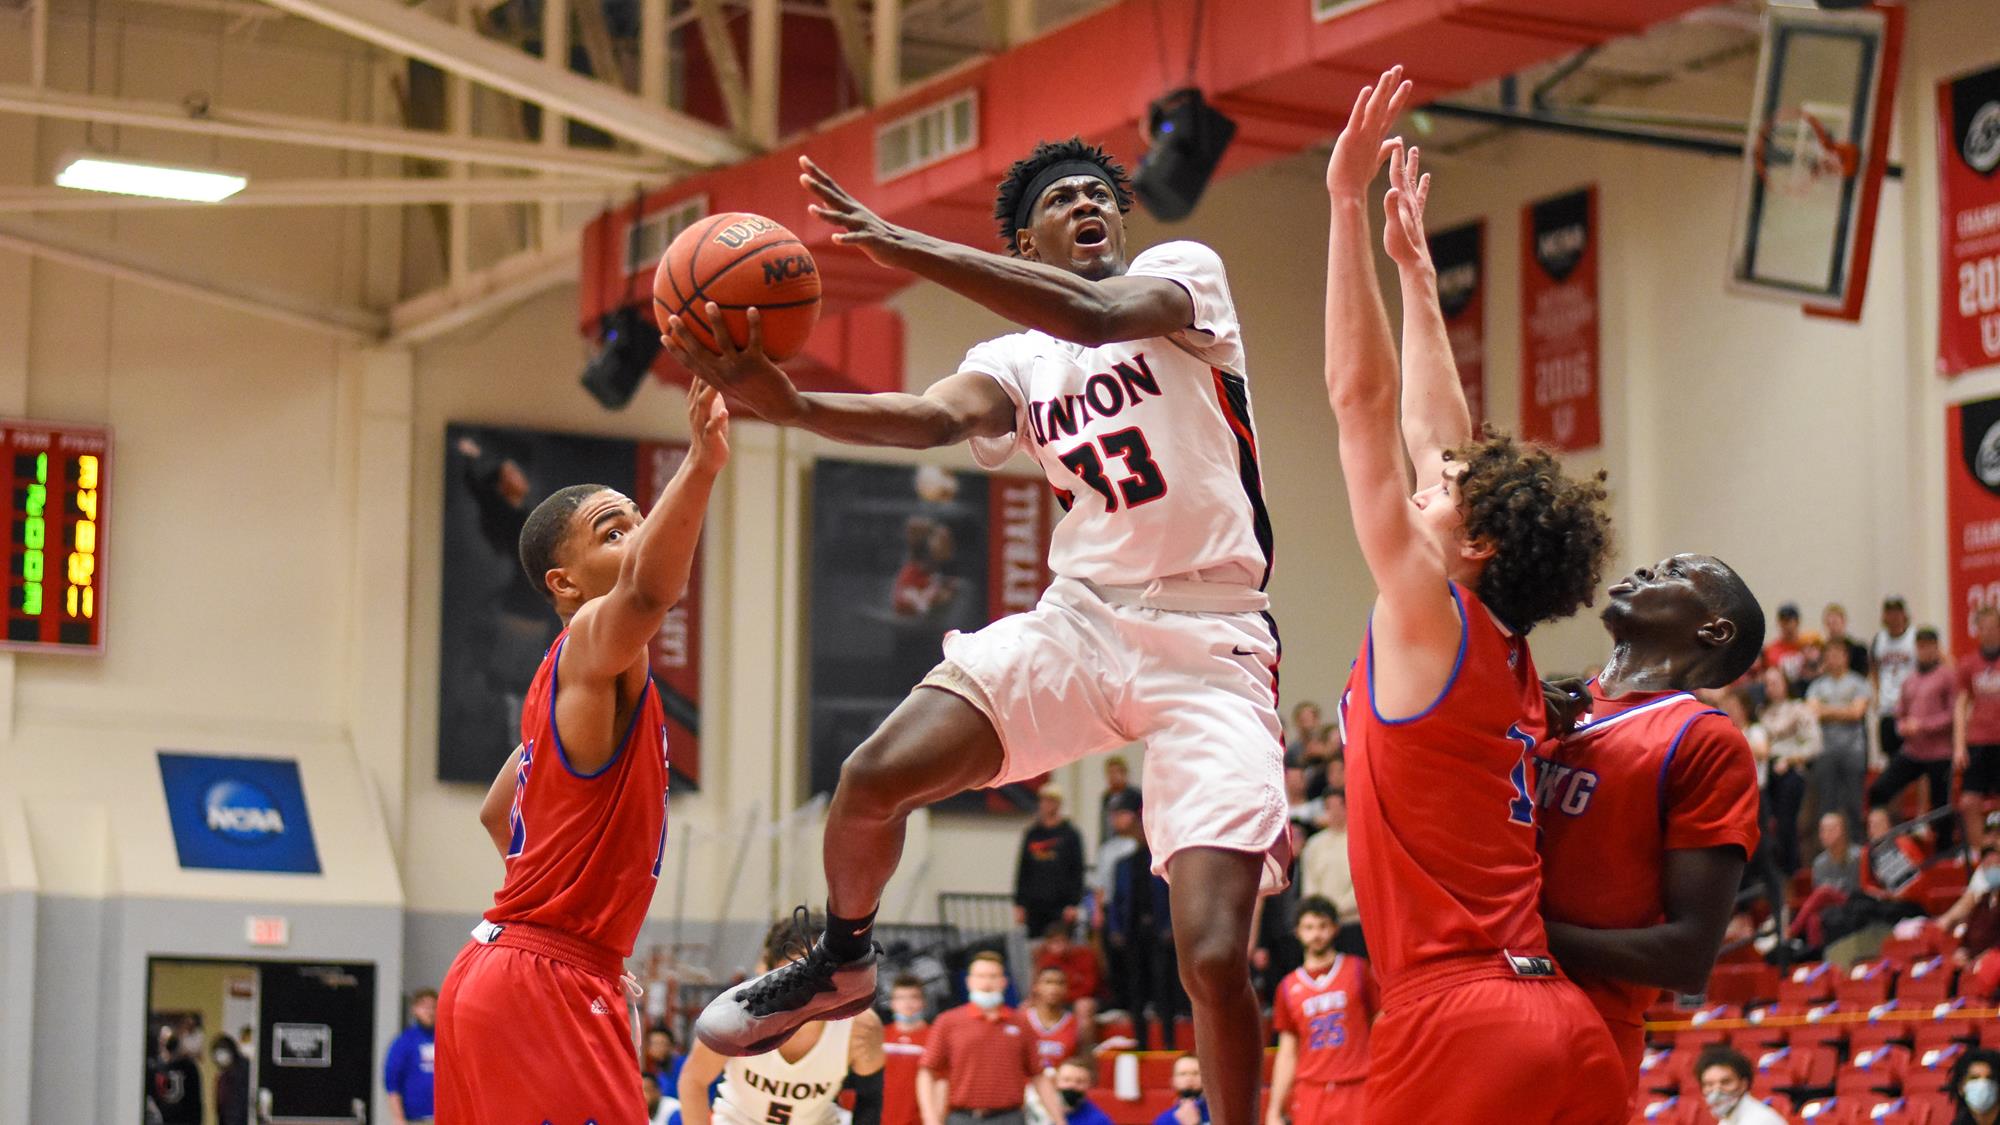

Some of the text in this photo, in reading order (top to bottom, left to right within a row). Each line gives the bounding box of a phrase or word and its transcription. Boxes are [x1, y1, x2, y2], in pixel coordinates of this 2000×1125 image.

[1029, 352, 1162, 448] UNION
[1058, 425, 1168, 514] 33
[66, 584, 94, 618] 11
[1533, 755, 1598, 817] WG
[207, 806, 284, 833] NCAA
[1310, 1012, 1345, 1050] 25
[744, 1068, 832, 1100] UNION
[766, 1101, 793, 1125] 5
